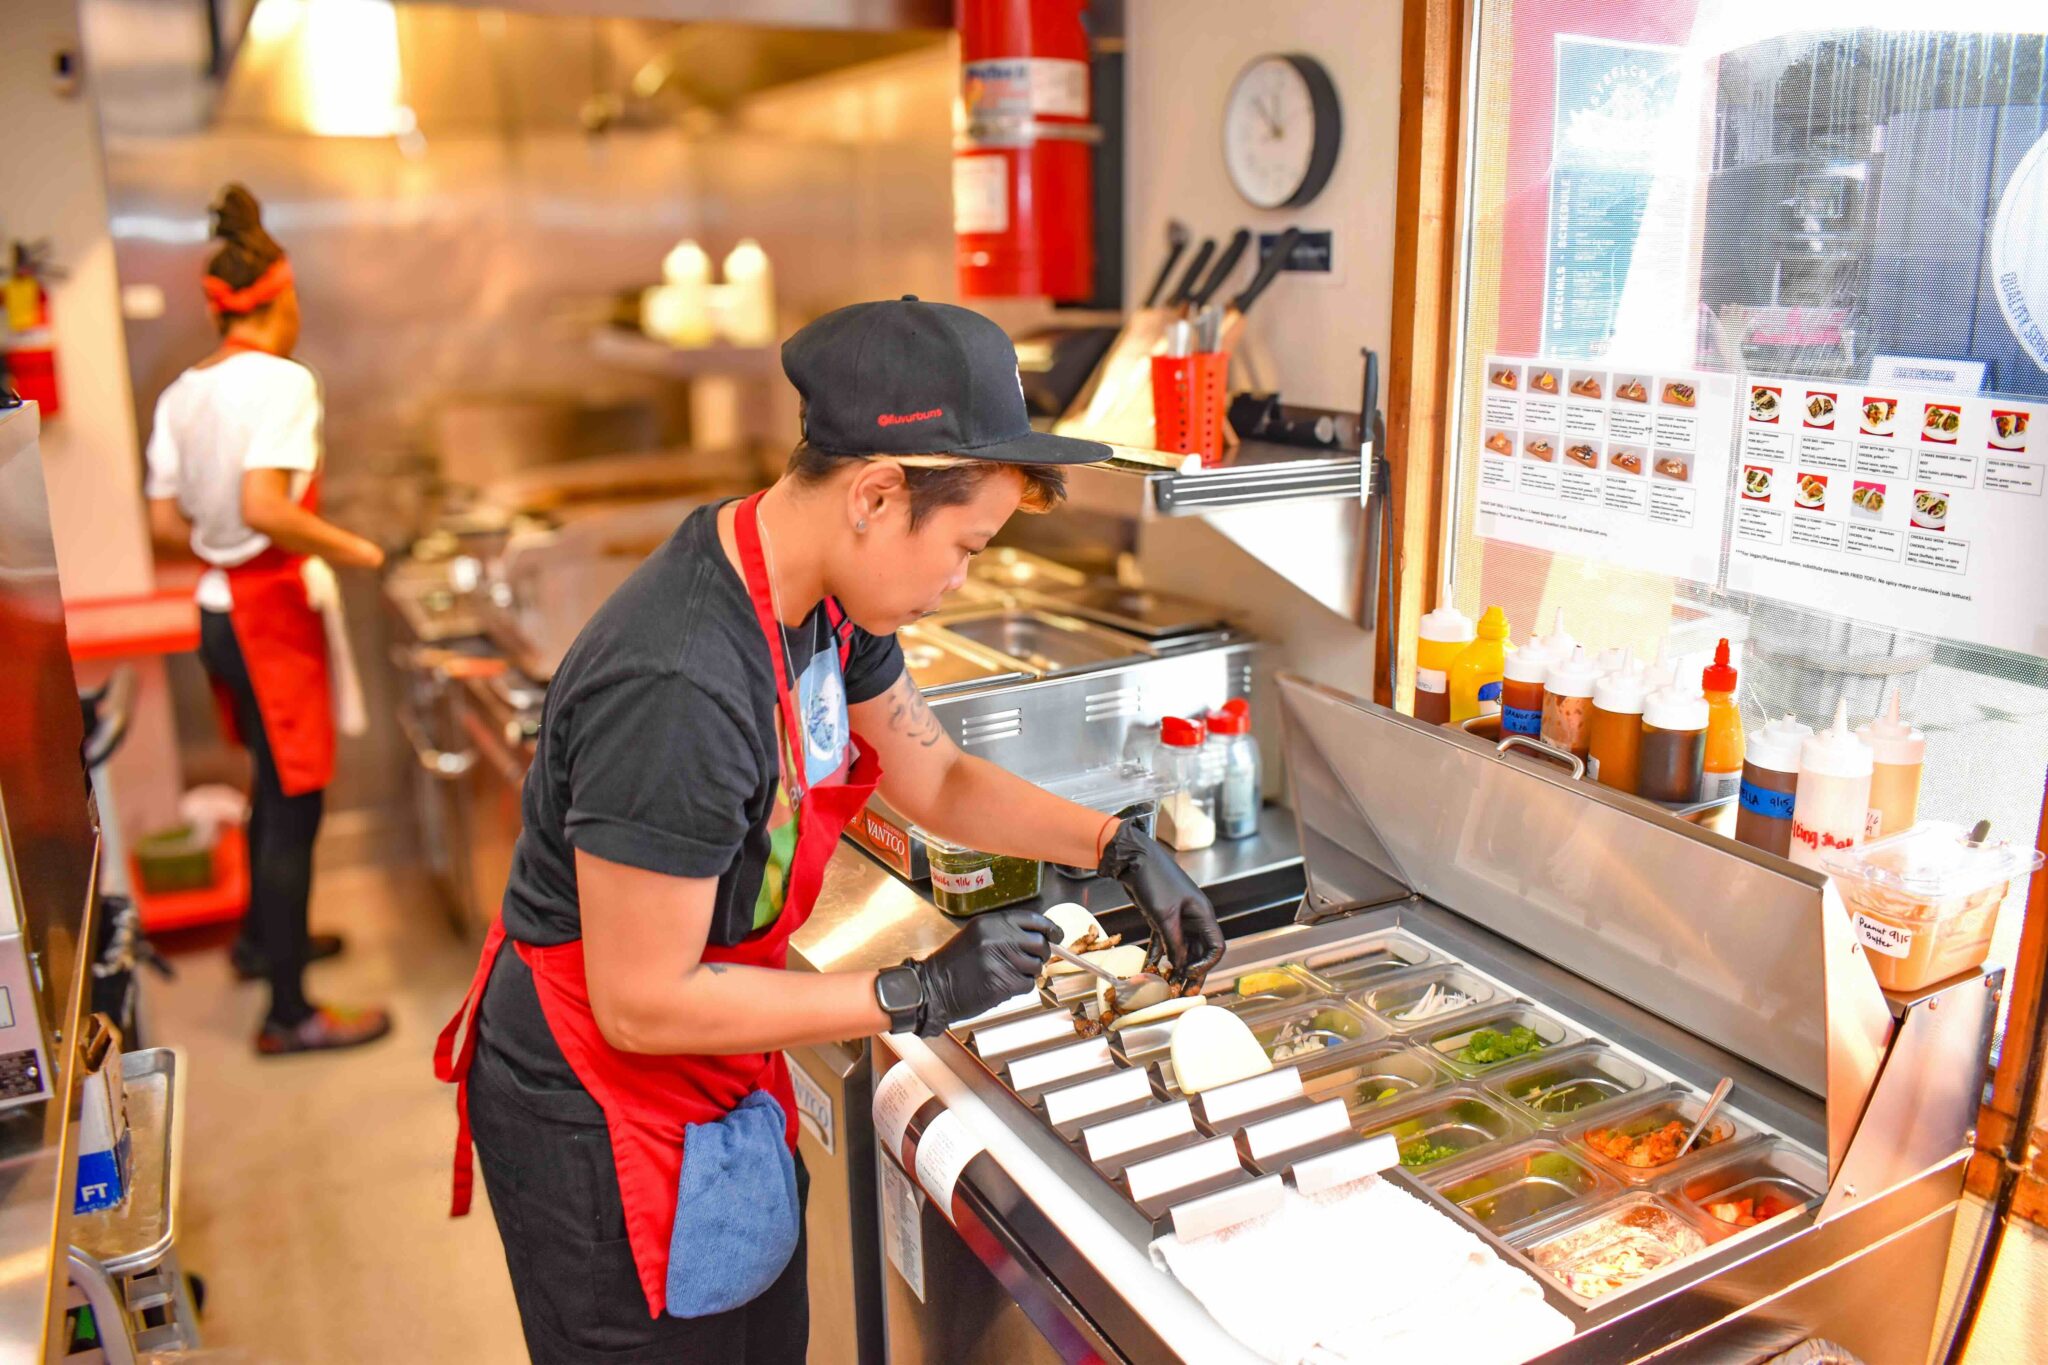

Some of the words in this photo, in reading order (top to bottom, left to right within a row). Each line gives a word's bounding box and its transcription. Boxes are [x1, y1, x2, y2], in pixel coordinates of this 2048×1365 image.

[2000, 272, 2029, 326] QUALITY
[1823, 567, 1839, 575] protein
[1850, 572, 1863, 580] FRIED
[1898, 582, 1911, 590] mayo
[1918, 586, 1939, 595] coleslaw
[1769, 798, 1789, 807] 9/15
[1792, 819, 1818, 850] lting
[1859, 916, 1887, 935] Peanut
[1888, 930, 1911, 944] 9/15
[1866, 931, 1893, 948] Butter
[81, 1182, 109, 1203] FT
